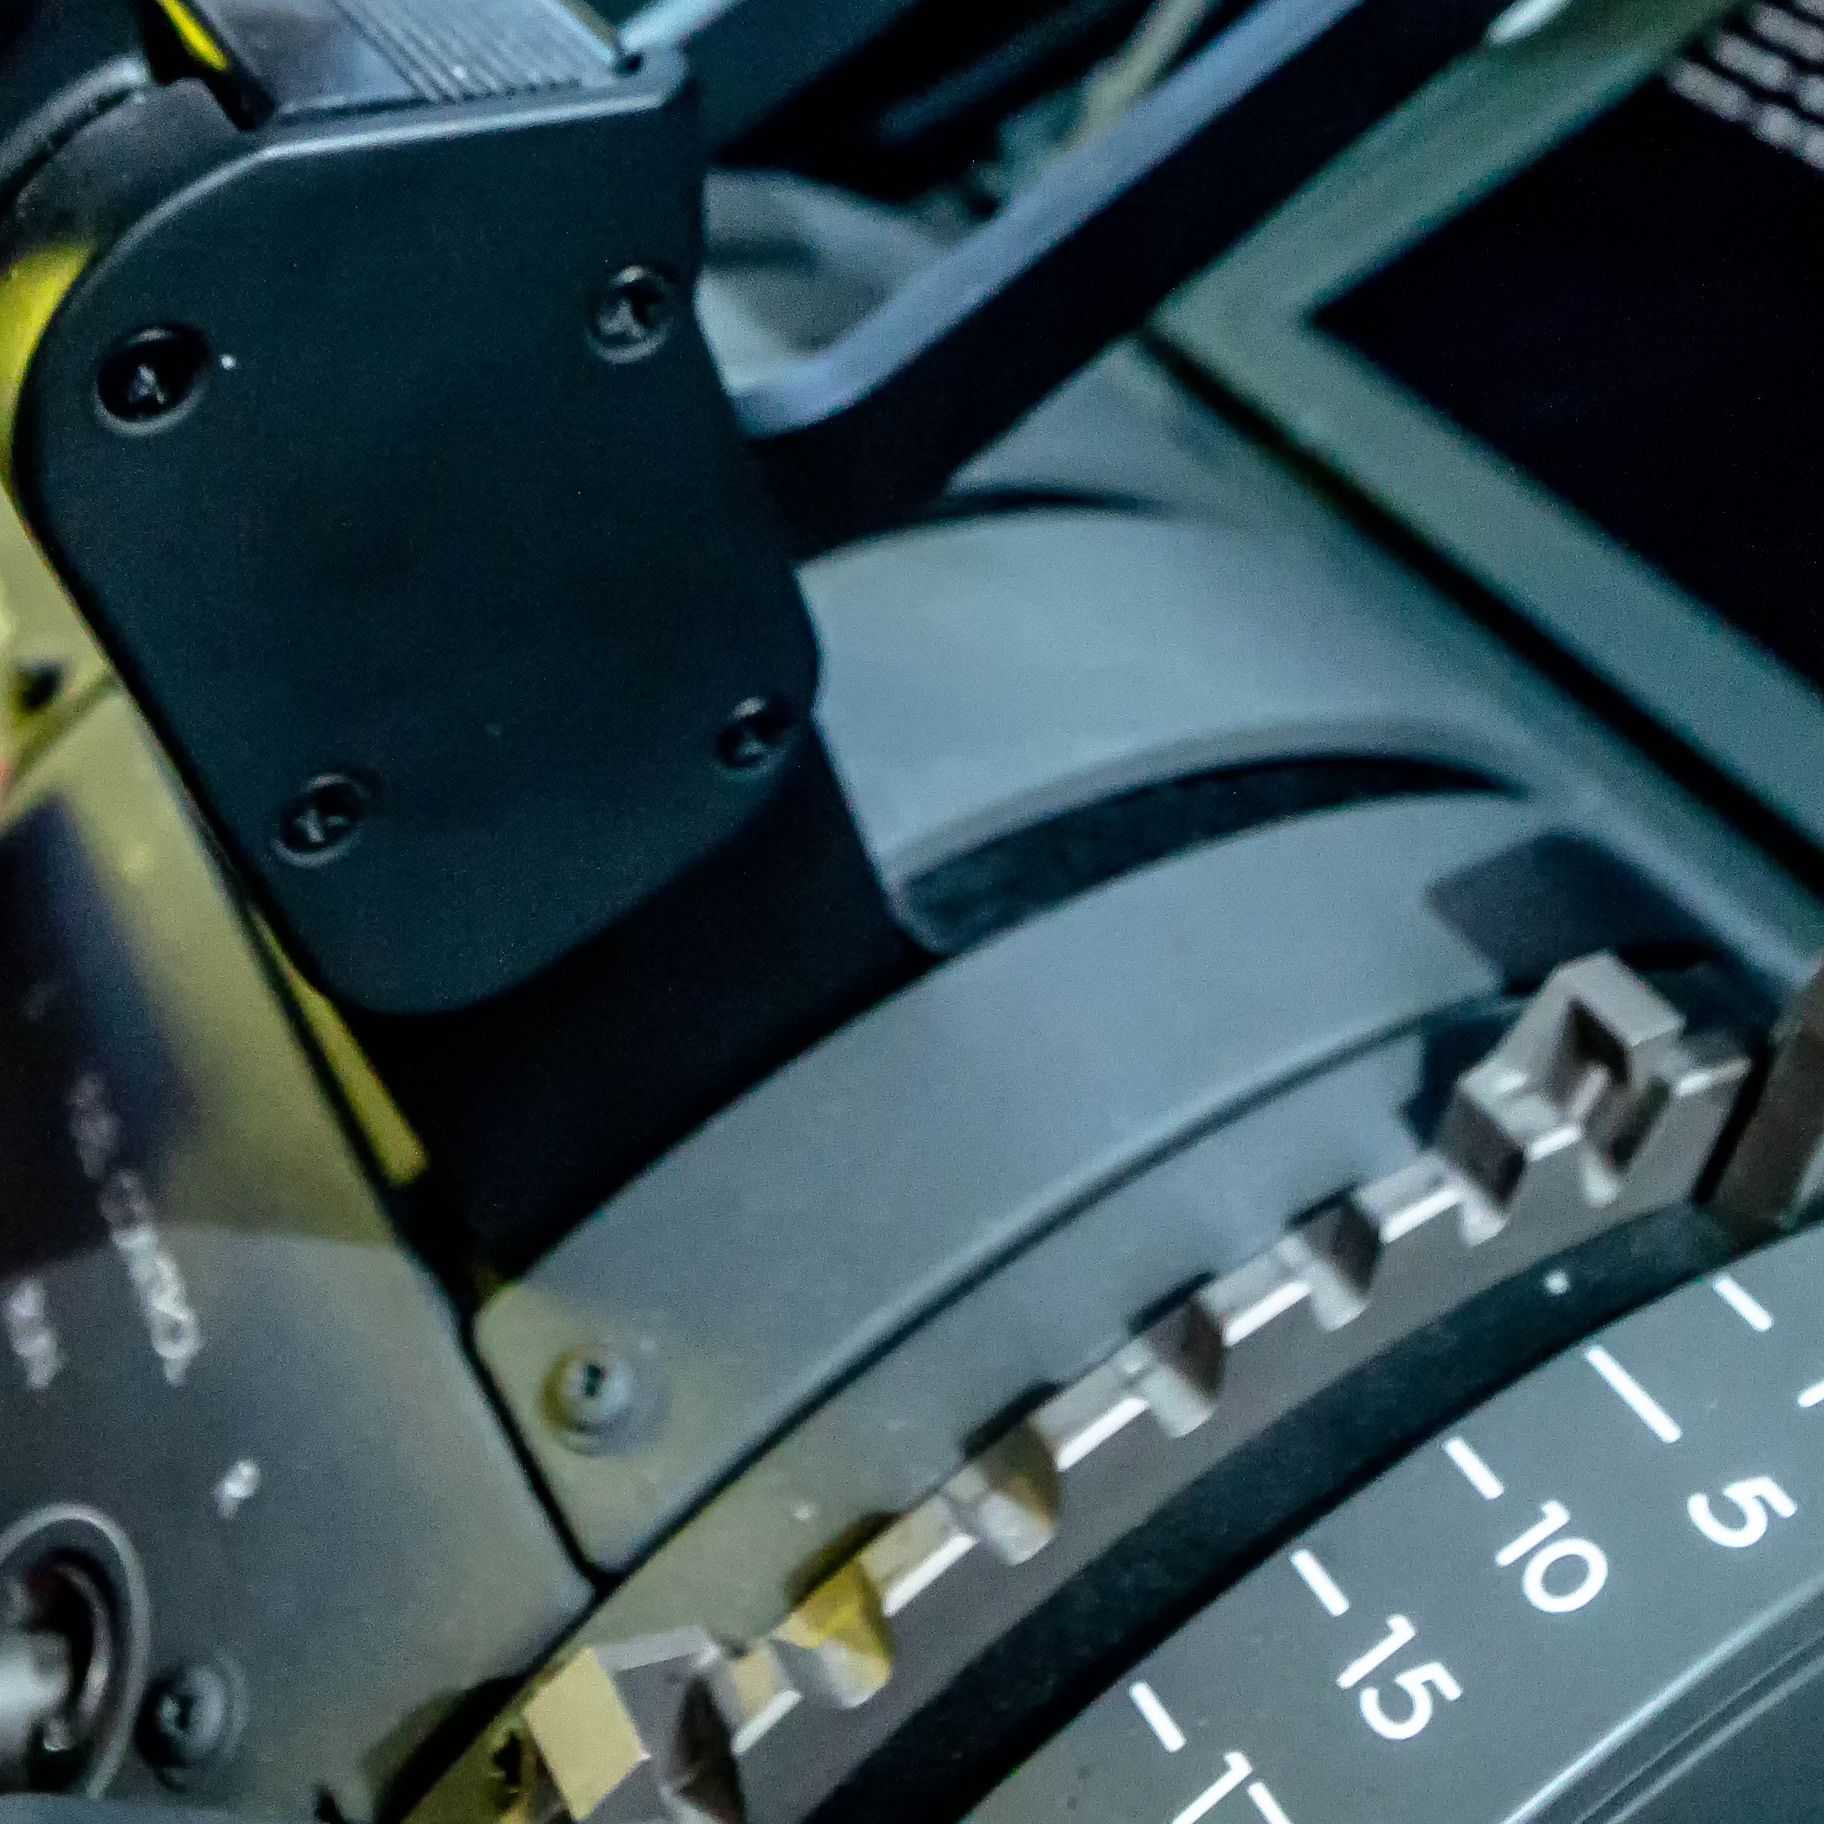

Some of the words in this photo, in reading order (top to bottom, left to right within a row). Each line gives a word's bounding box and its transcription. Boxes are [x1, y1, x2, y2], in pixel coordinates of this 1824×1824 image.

[1495, 1500, 1608, 1612] 10
[1687, 1476, 1796, 1547] 5
[1336, 1614, 1462, 1740] 15
